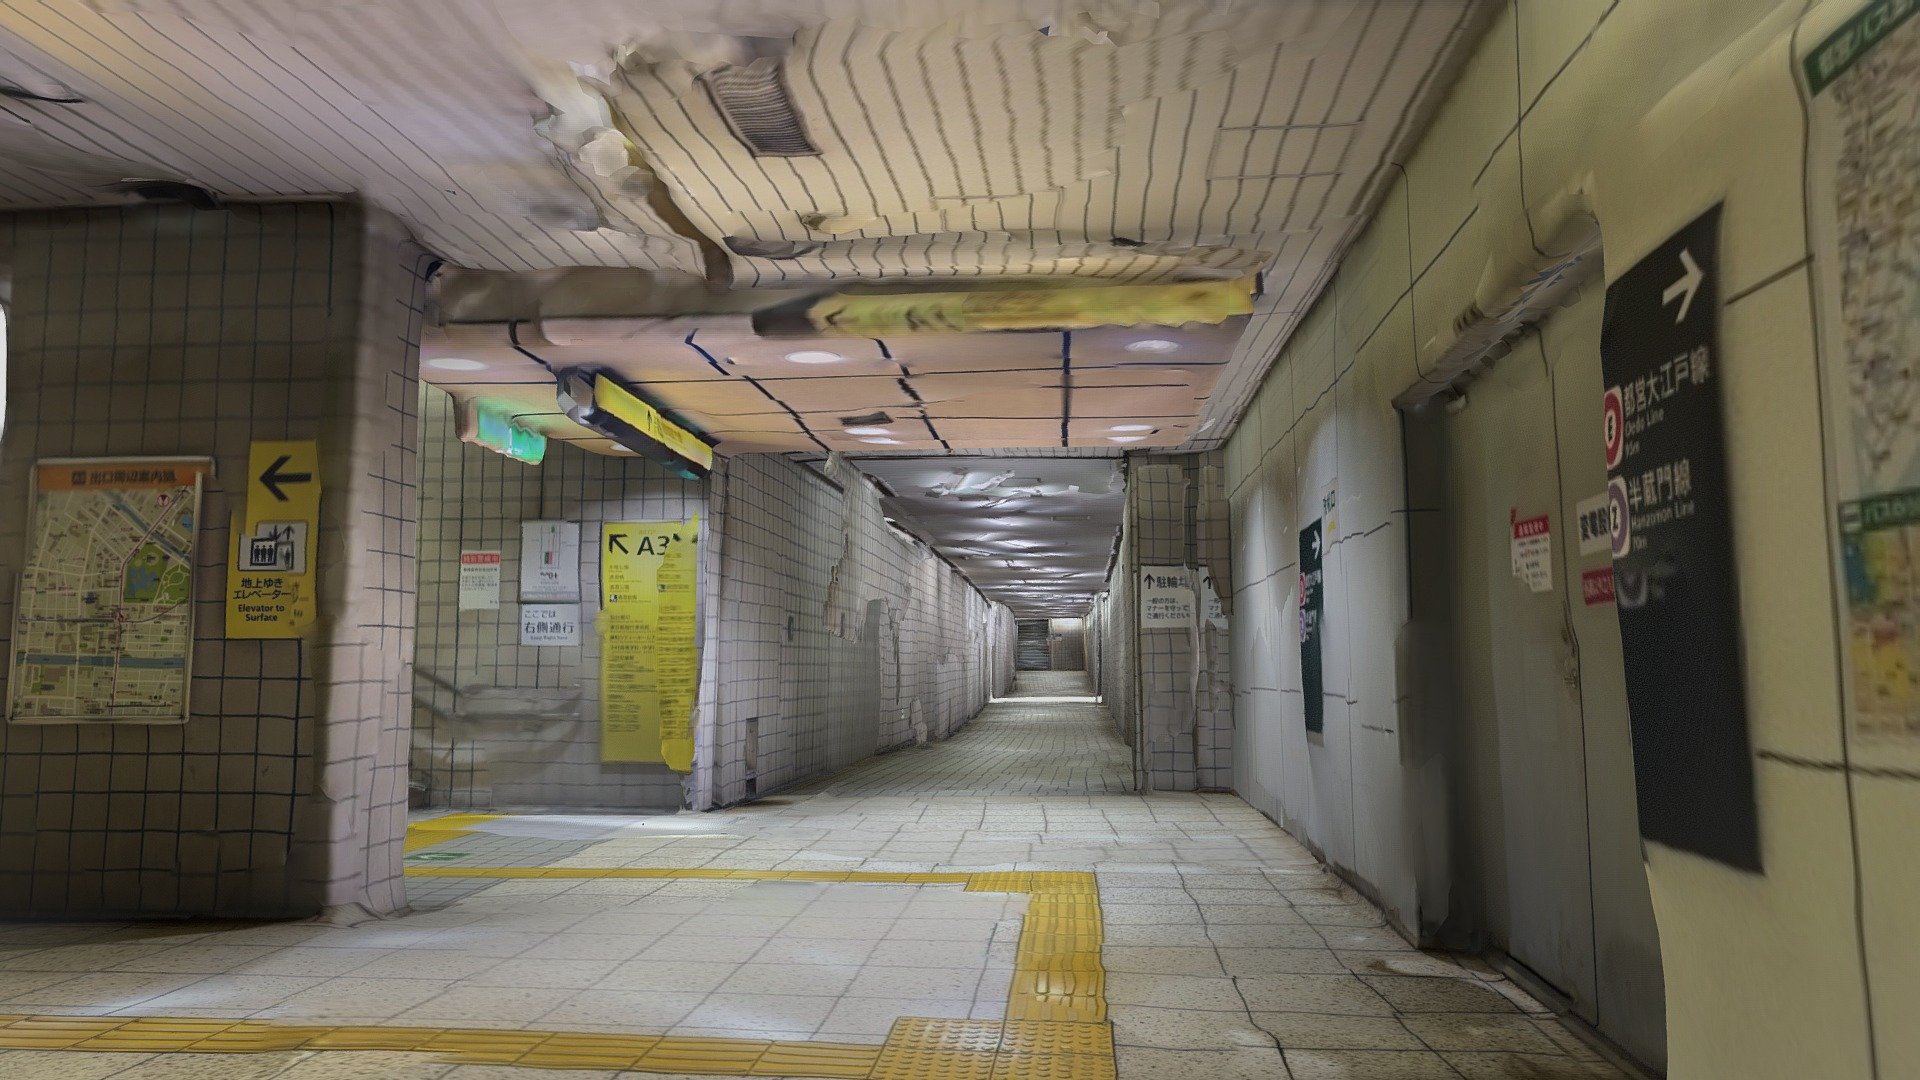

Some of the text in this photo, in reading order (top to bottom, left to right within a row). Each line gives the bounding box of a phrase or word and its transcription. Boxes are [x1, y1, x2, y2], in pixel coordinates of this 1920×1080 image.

[1612, 506, 1619, 530] Z
[637, 536, 670, 556] A3
[241, 577, 284, 589] 地上ゆき
[232, 590, 292, 600] エレベーター
[238, 603, 285, 613] Elevator to
[245, 613, 278, 622] Surface
[524, 610, 556, 619] ここでは
[524, 621, 575, 634] 右側通行
